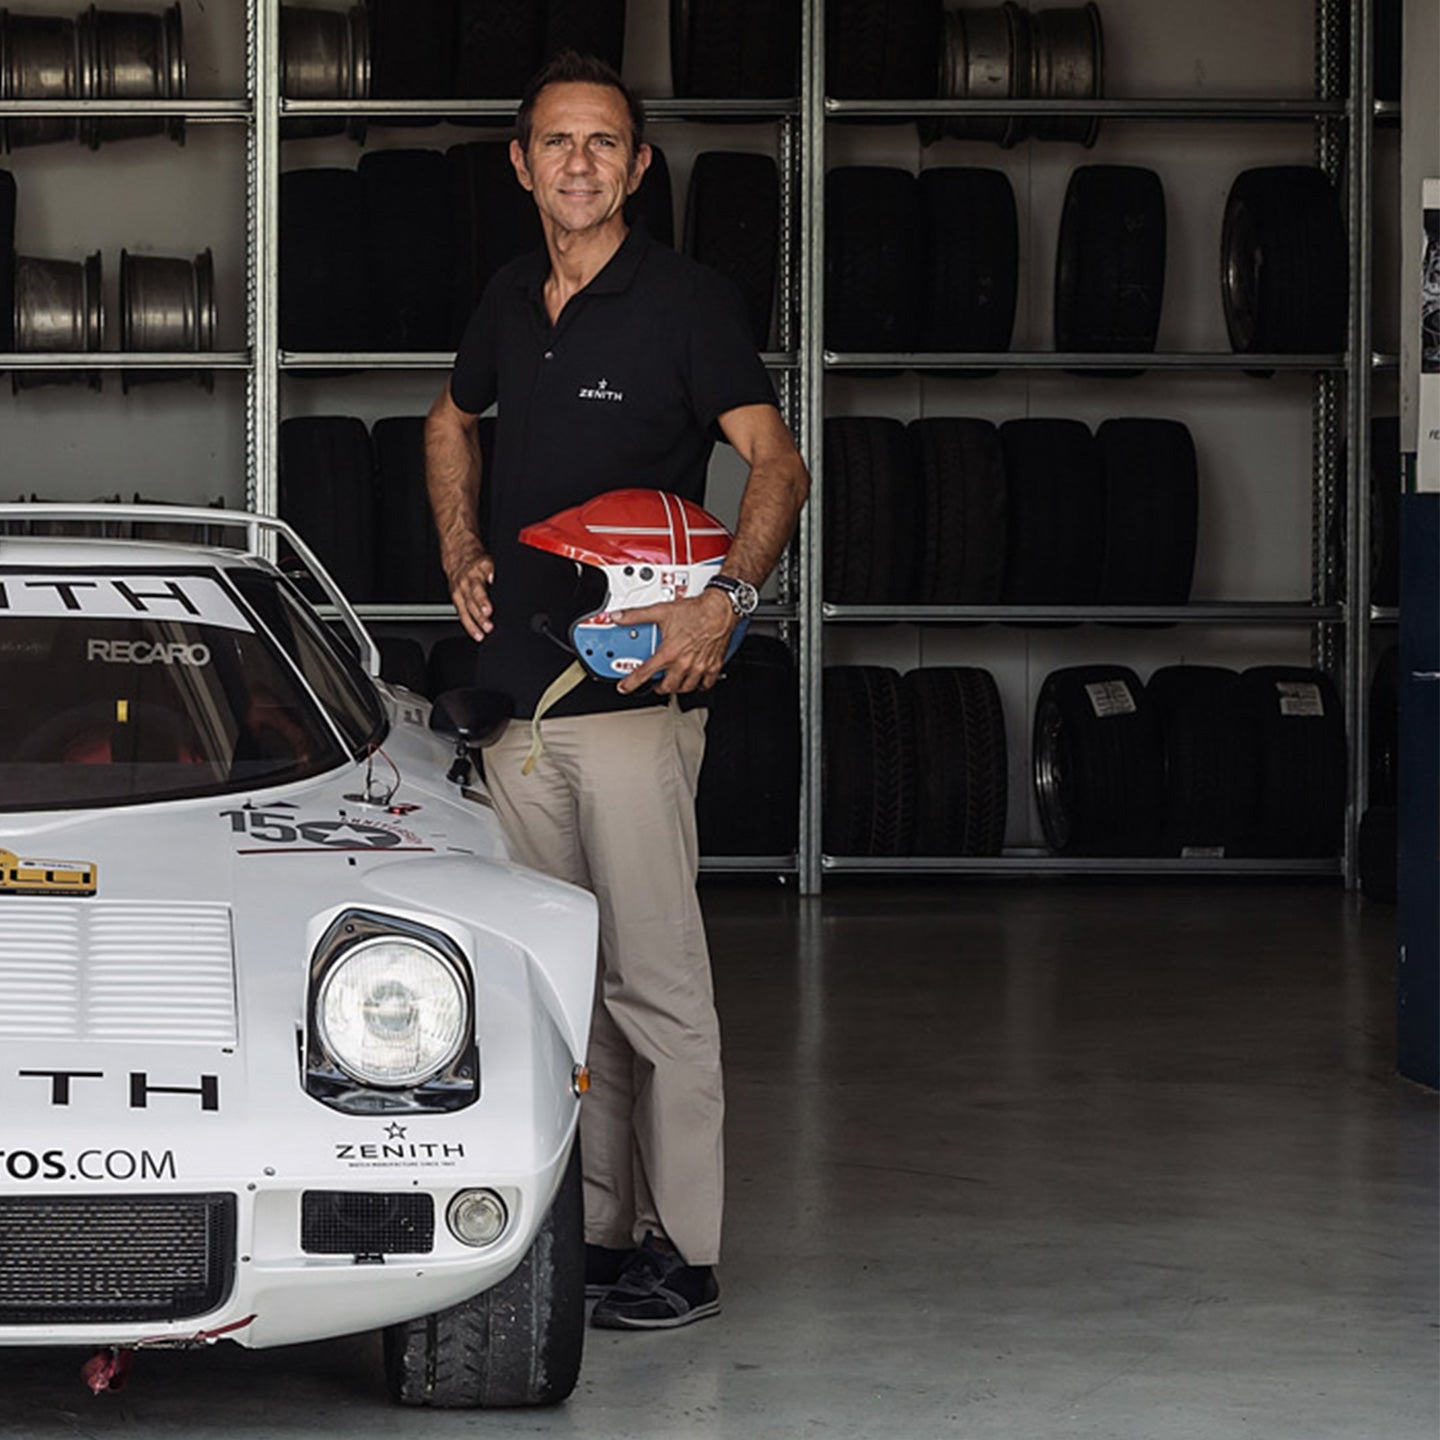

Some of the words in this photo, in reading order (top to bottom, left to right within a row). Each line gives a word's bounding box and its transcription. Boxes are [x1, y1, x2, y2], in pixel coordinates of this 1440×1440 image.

[578, 388, 623, 402] ZENITH
[87, 639, 211, 667] RECARO
[335, 1143, 465, 1159] ZENITH
